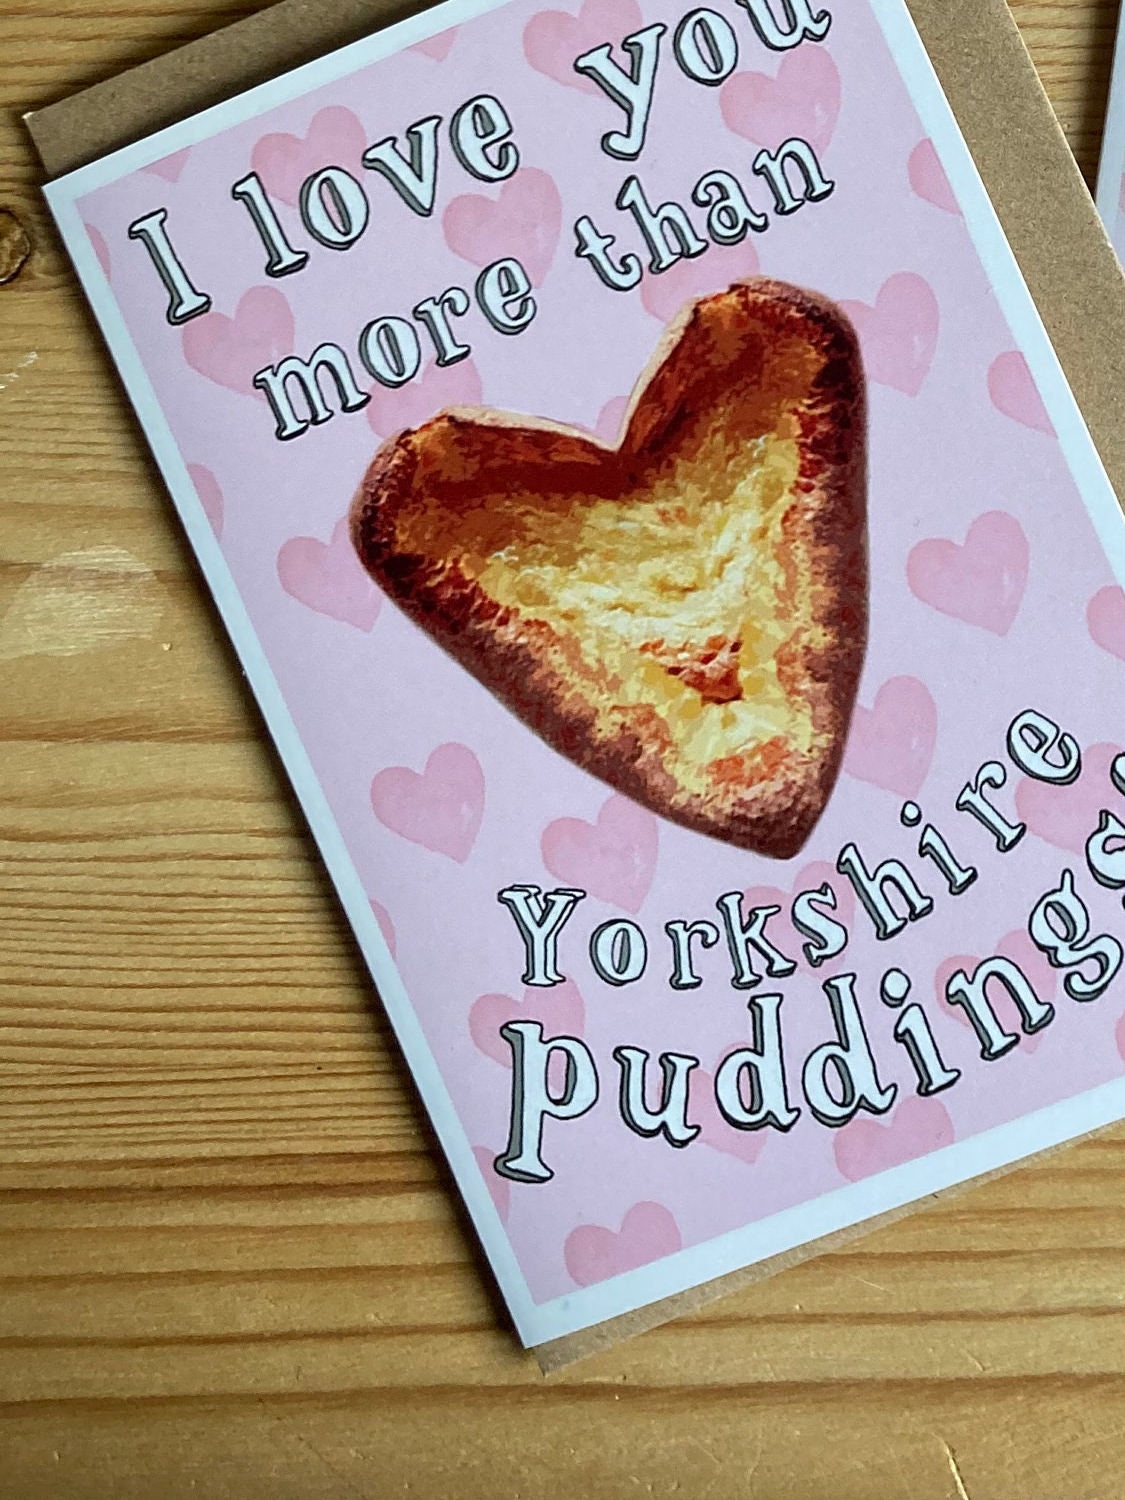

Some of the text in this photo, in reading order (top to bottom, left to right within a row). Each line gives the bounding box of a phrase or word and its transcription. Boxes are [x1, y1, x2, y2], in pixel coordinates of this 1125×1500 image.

[130, 209, 211, 325] I
[232, 94, 519, 277] love
[254, 137, 834, 441] more than
[498, 708, 1081, 989] Yorkshire
